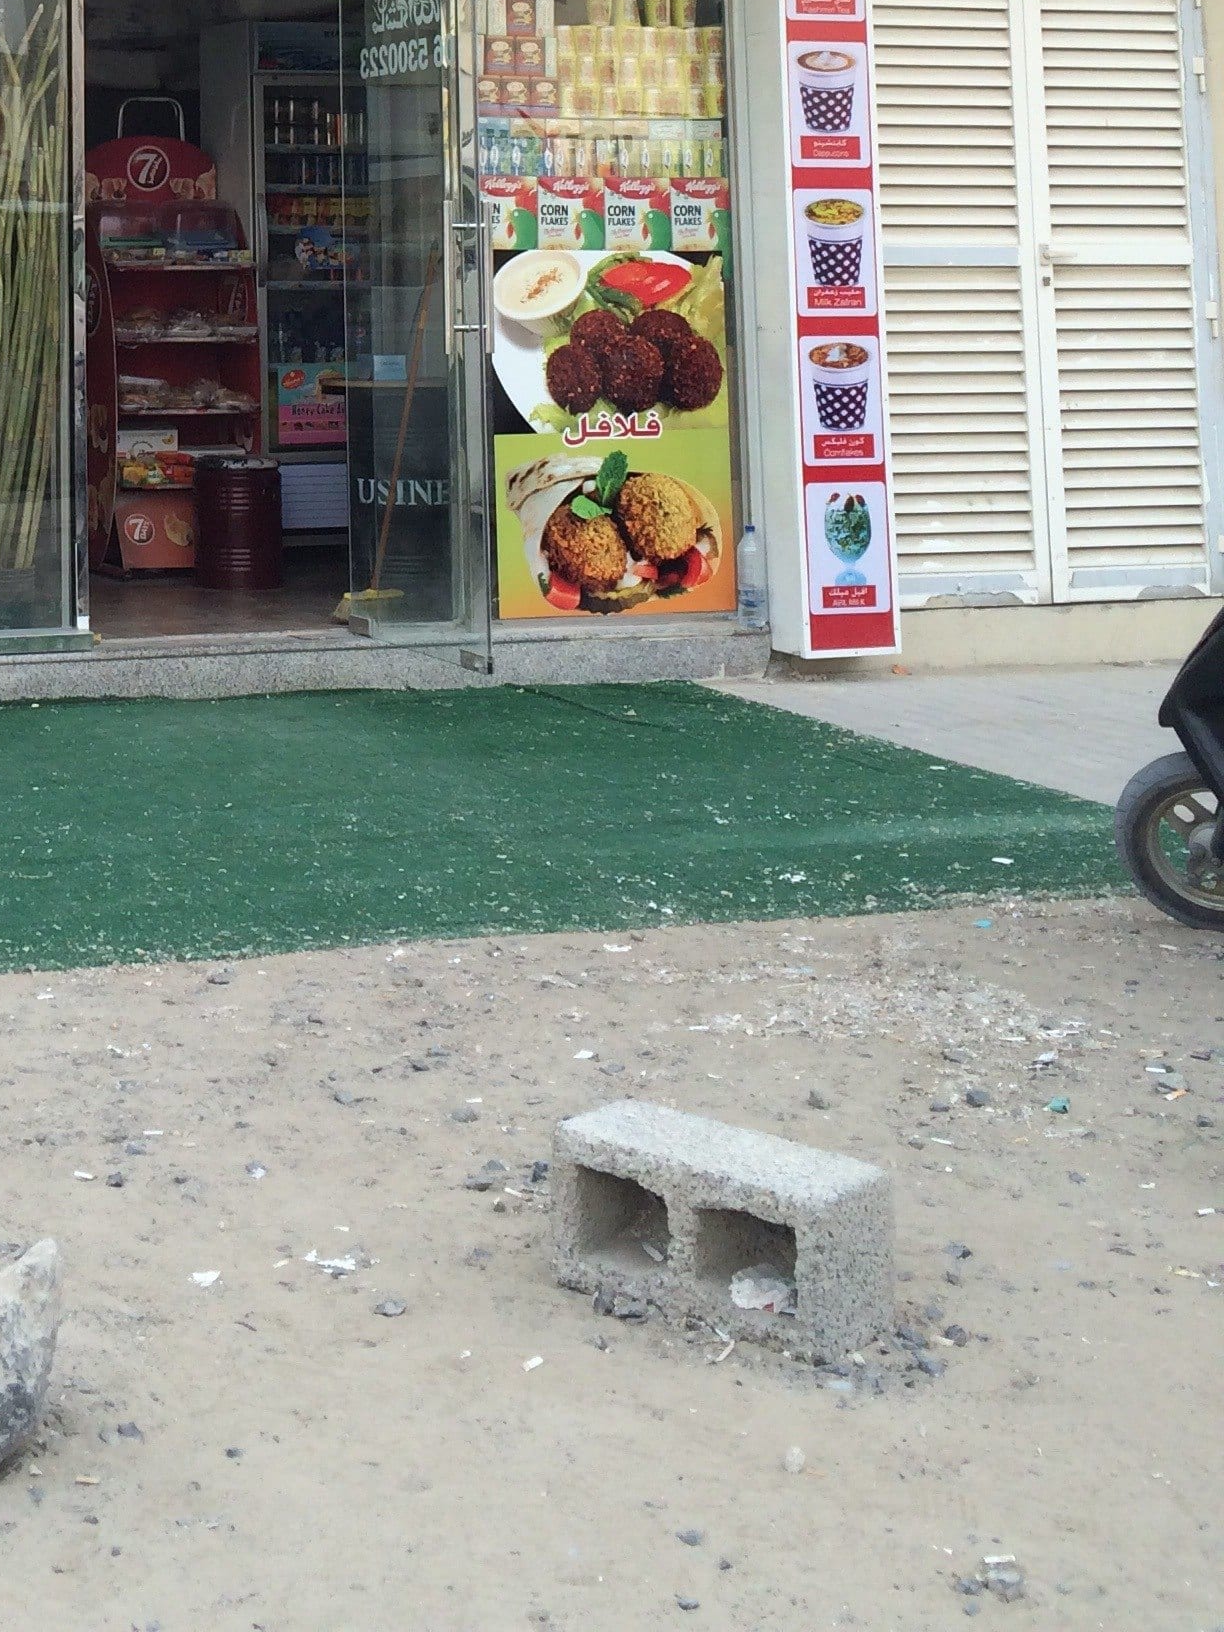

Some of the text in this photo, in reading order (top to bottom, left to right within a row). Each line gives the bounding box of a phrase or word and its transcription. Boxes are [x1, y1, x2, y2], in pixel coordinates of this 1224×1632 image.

[540, 204, 569, 216] CORN
[607, 205, 636, 217] CORN
[673, 205, 702, 217] CORN
[540, 216, 569, 226] FLAKES
[607, 217, 636, 226] FLAKES
[674, 217, 703, 226] FLAKES
[814, 297, 862, 307] Milk Zafran
[563, 410, 663, 448] فلافل
